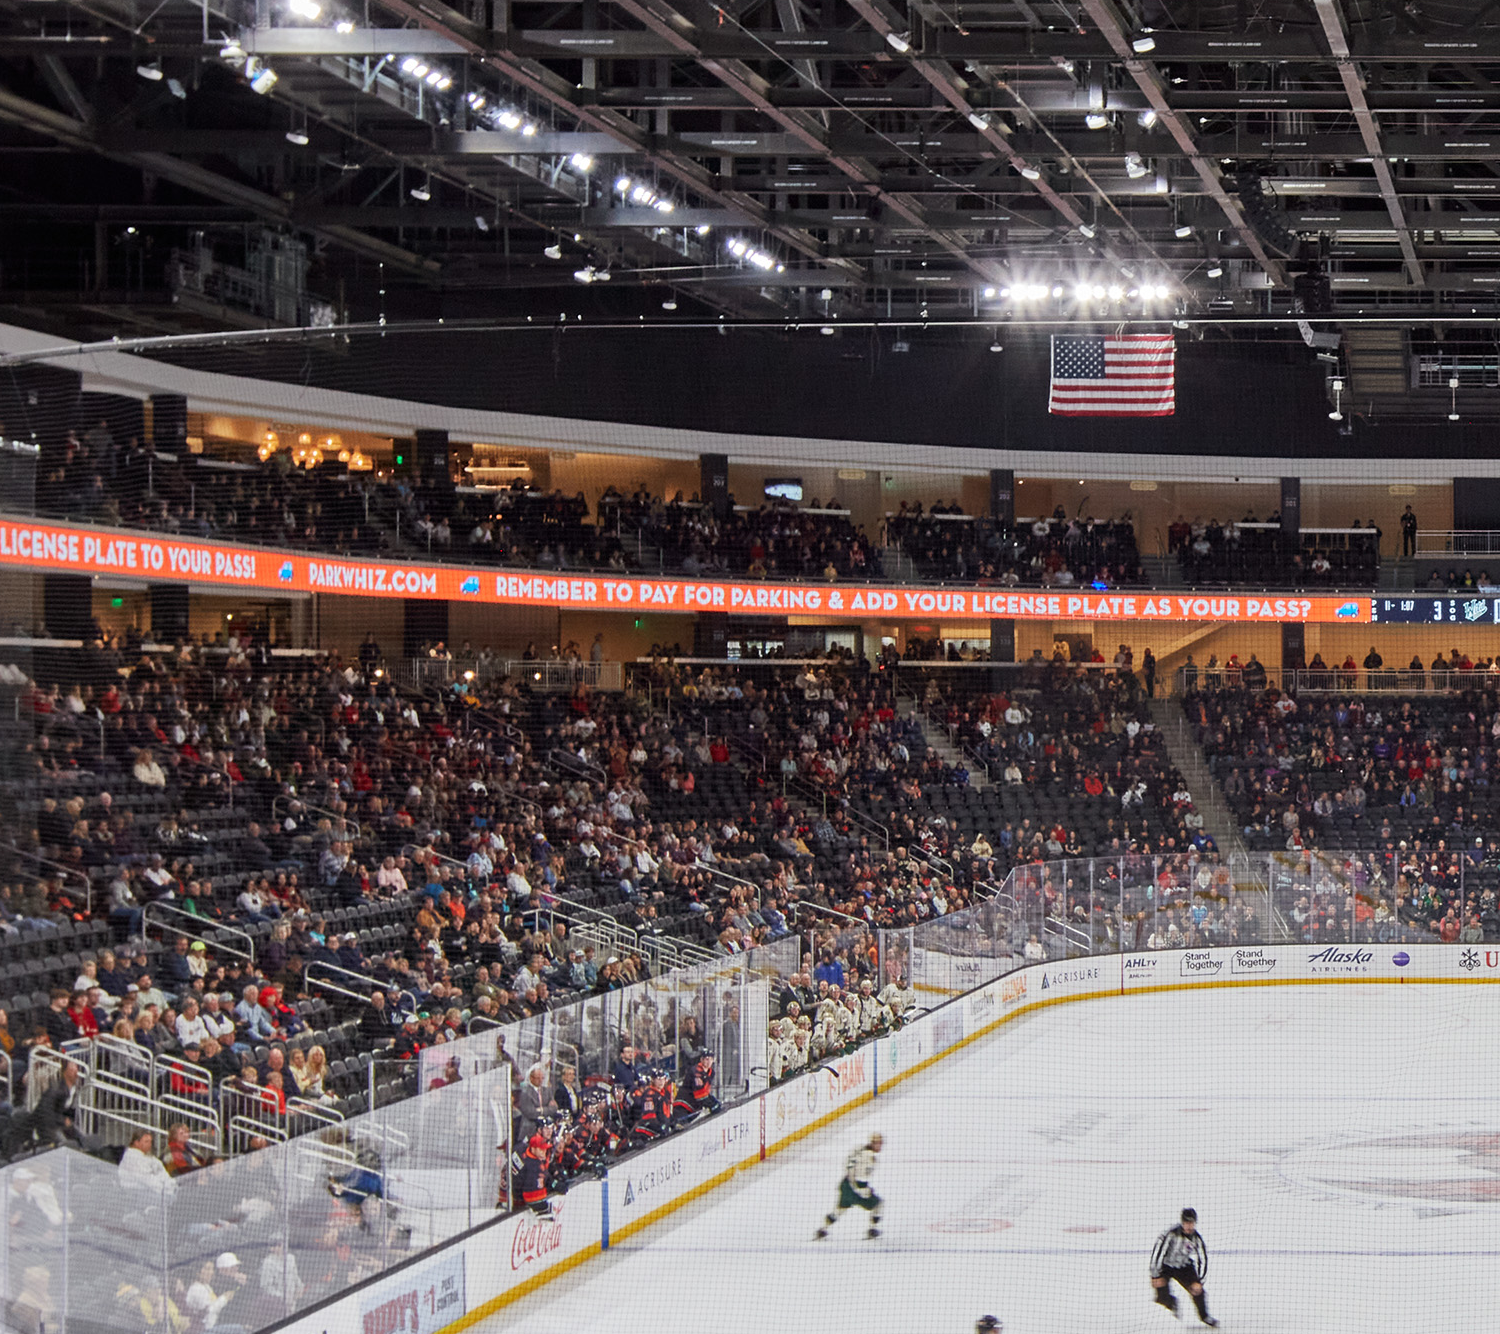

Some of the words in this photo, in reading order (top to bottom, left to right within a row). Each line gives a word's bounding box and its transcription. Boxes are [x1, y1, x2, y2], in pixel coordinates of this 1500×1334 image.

[0, 528, 79, 561] LICENSE
[84, 537, 137, 567] PLATE
[141, 544, 164, 569] TO
[168, 547, 212, 574] YOUR
[215, 552, 256, 578] PASS!
[309, 563, 437, 593] PARKWHIZ.COM
[496, 576, 597, 601] REMEMBER
[604, 582, 633, 602] TO
[640, 584, 678, 603] PAY
[684, 586, 725, 605] FOR
[731, 588, 822, 609] PARKING
[828, 591, 844, 609] &
[851, 592, 898, 610] ADD
[905, 593, 966, 611] YOUR
[972, 595, 1061, 615] LICENSE
[1068, 597, 1137, 617] PLATE
[1143, 599, 1172, 616] AS
[1178, 599, 1240, 617] YOUR
[1247, 600, 1312, 617] PASS?
[1434, 601, 1442, 621] 3
[1185, 952, 1210, 960] Stand
[1236, 950, 1263, 958] Stand
[1237, 957, 1276, 967] Together
[1308, 947, 1373, 964] Alaska
[1186, 960, 1223, 970] Together
[1052, 968, 1099, 986] ACRISURE
[637, 1159, 682, 1195] ACRISURE
